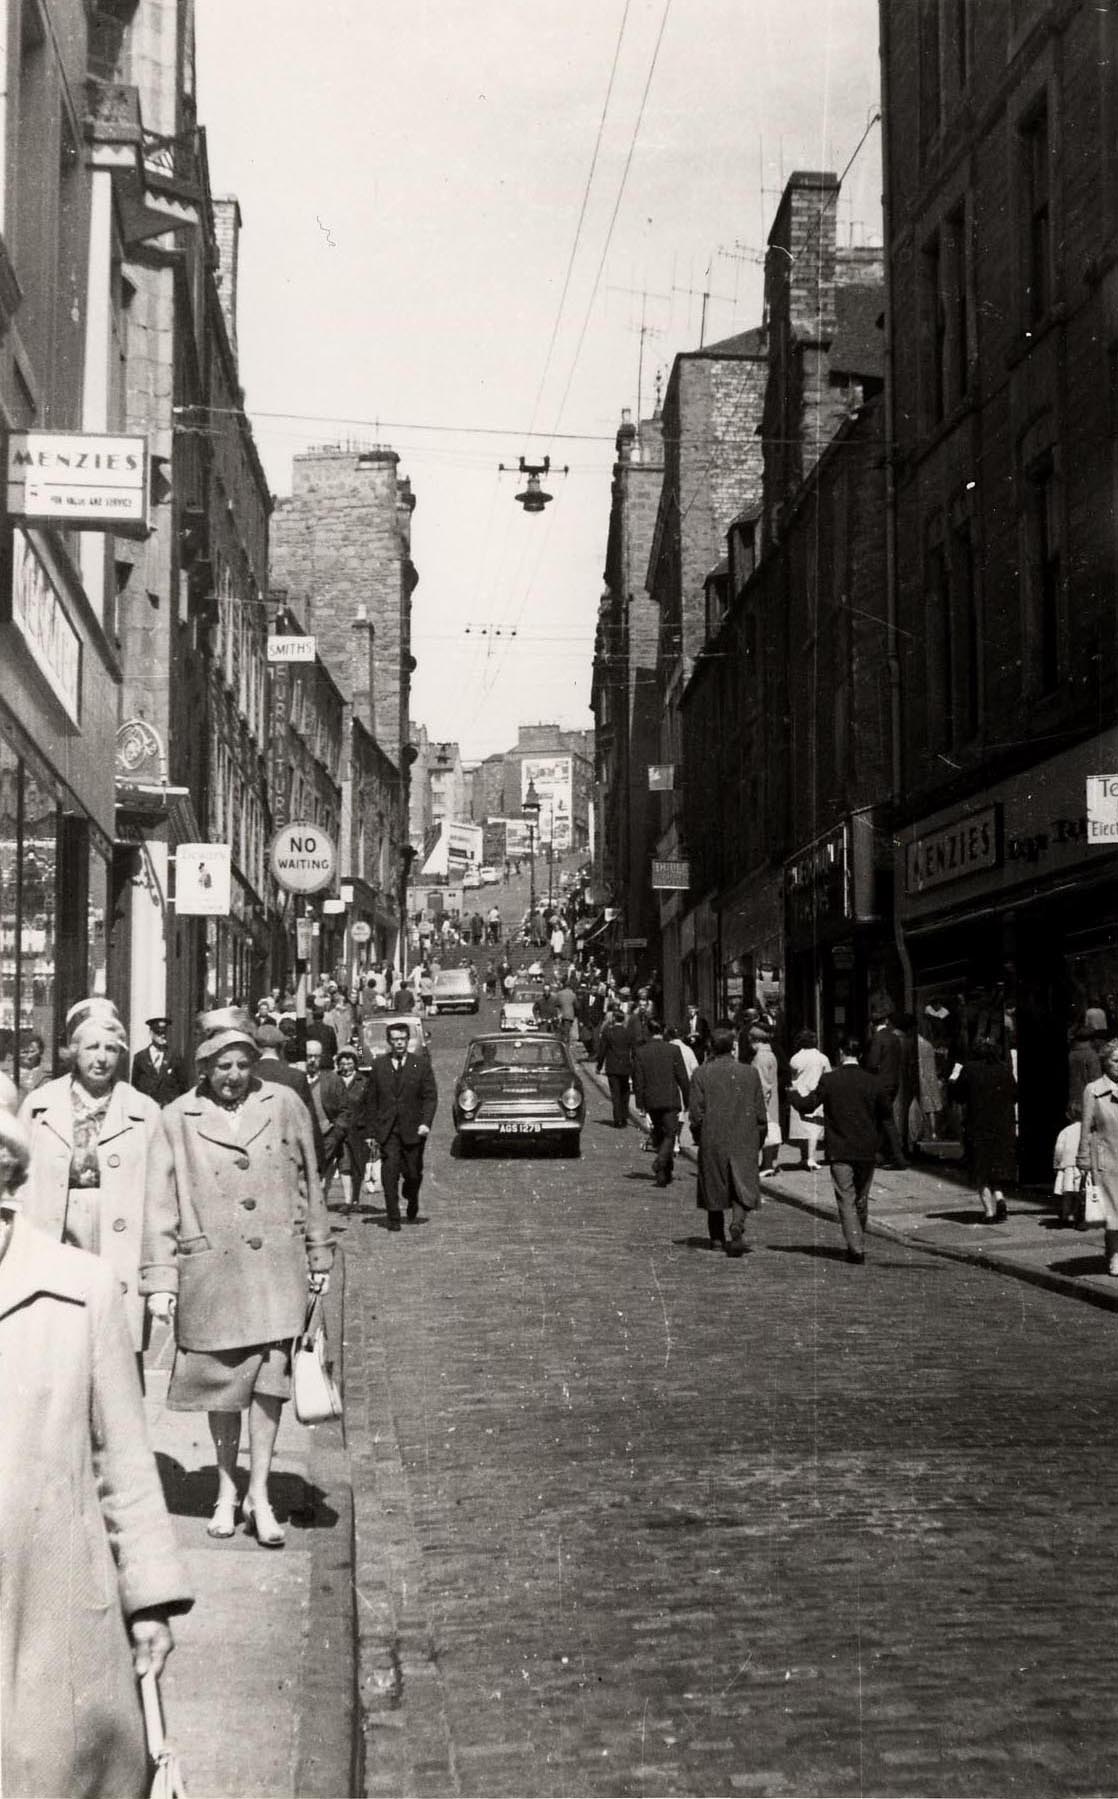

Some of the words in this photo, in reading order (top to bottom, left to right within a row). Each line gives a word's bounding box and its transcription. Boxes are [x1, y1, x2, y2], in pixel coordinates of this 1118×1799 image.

[12, 451, 137, 470] MENZIES
[290, 837, 316, 853] NO
[278, 859, 329, 869] WAITING
[500, 1124, 518, 1133] AGS
